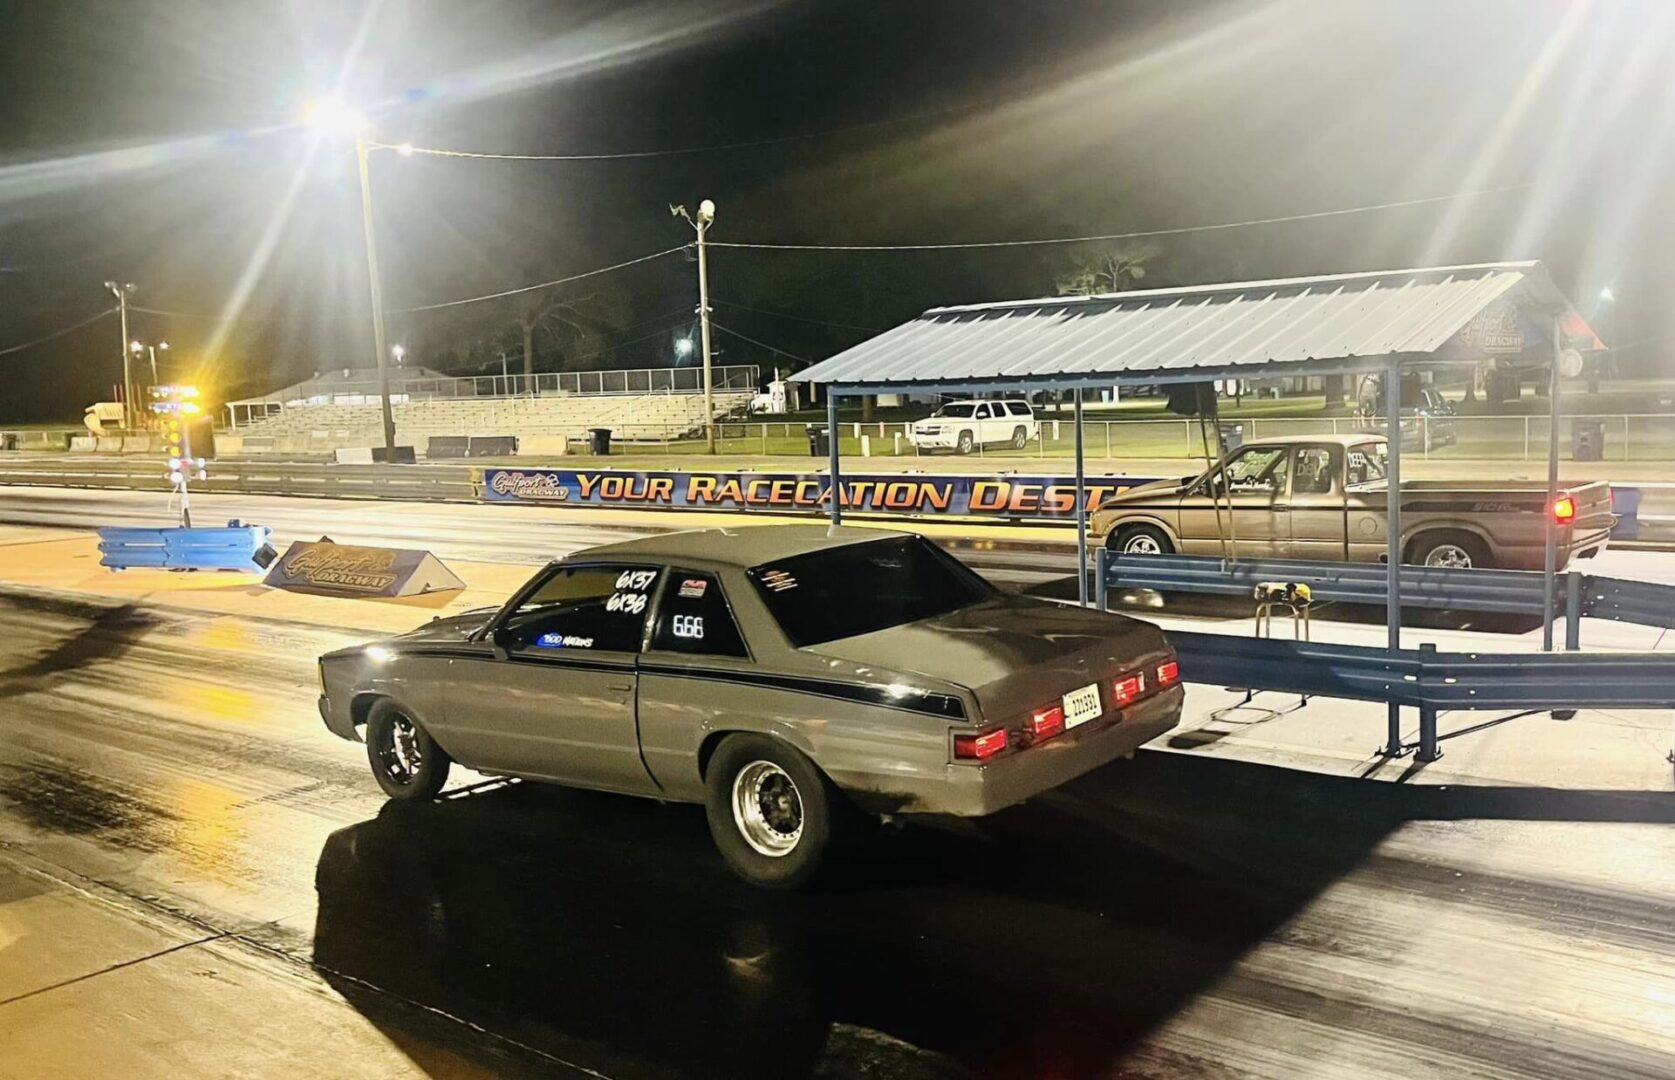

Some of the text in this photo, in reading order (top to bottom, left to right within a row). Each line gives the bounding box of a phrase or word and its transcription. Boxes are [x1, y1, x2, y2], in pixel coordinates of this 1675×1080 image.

[519, 489, 566, 497] DRAGWAY
[576, 474, 673, 500] YOUR
[686, 474, 952, 508] RACECATION
[318, 571, 393, 588] DRAGWAY
[615, 570, 657, 591] 6X37
[672, 614, 704, 639] 666
